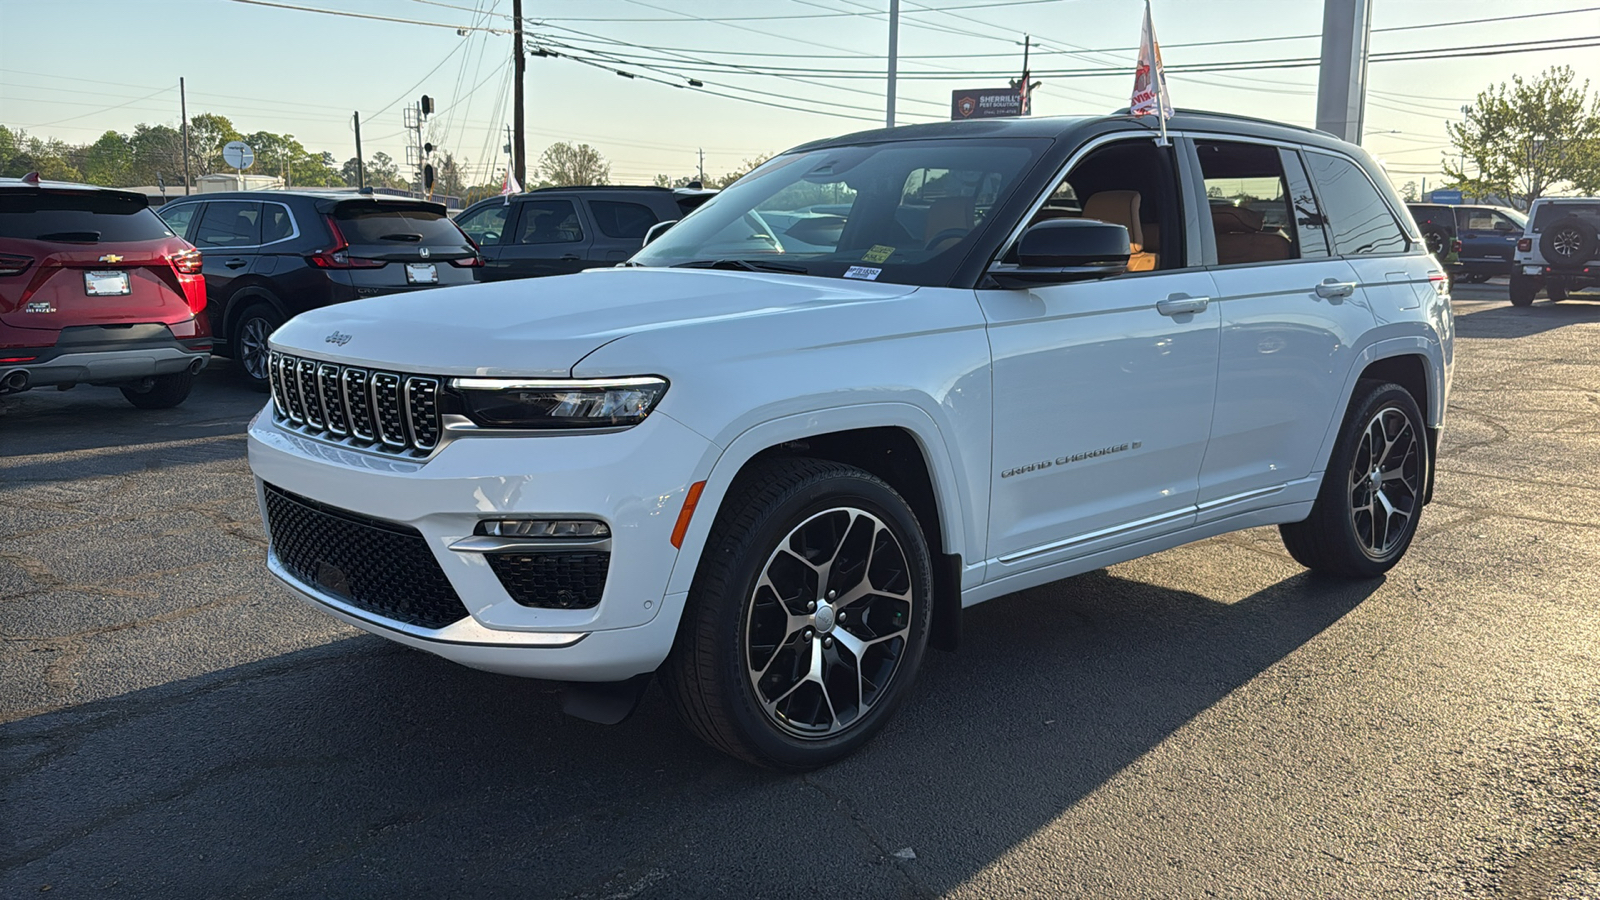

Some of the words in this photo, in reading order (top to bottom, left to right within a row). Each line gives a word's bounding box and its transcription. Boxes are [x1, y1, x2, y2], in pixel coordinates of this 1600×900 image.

[325, 330, 353, 347] Jeep
[1001, 459, 1053, 479] GRAND
[1055, 442, 1129, 466] CHEROKEE
